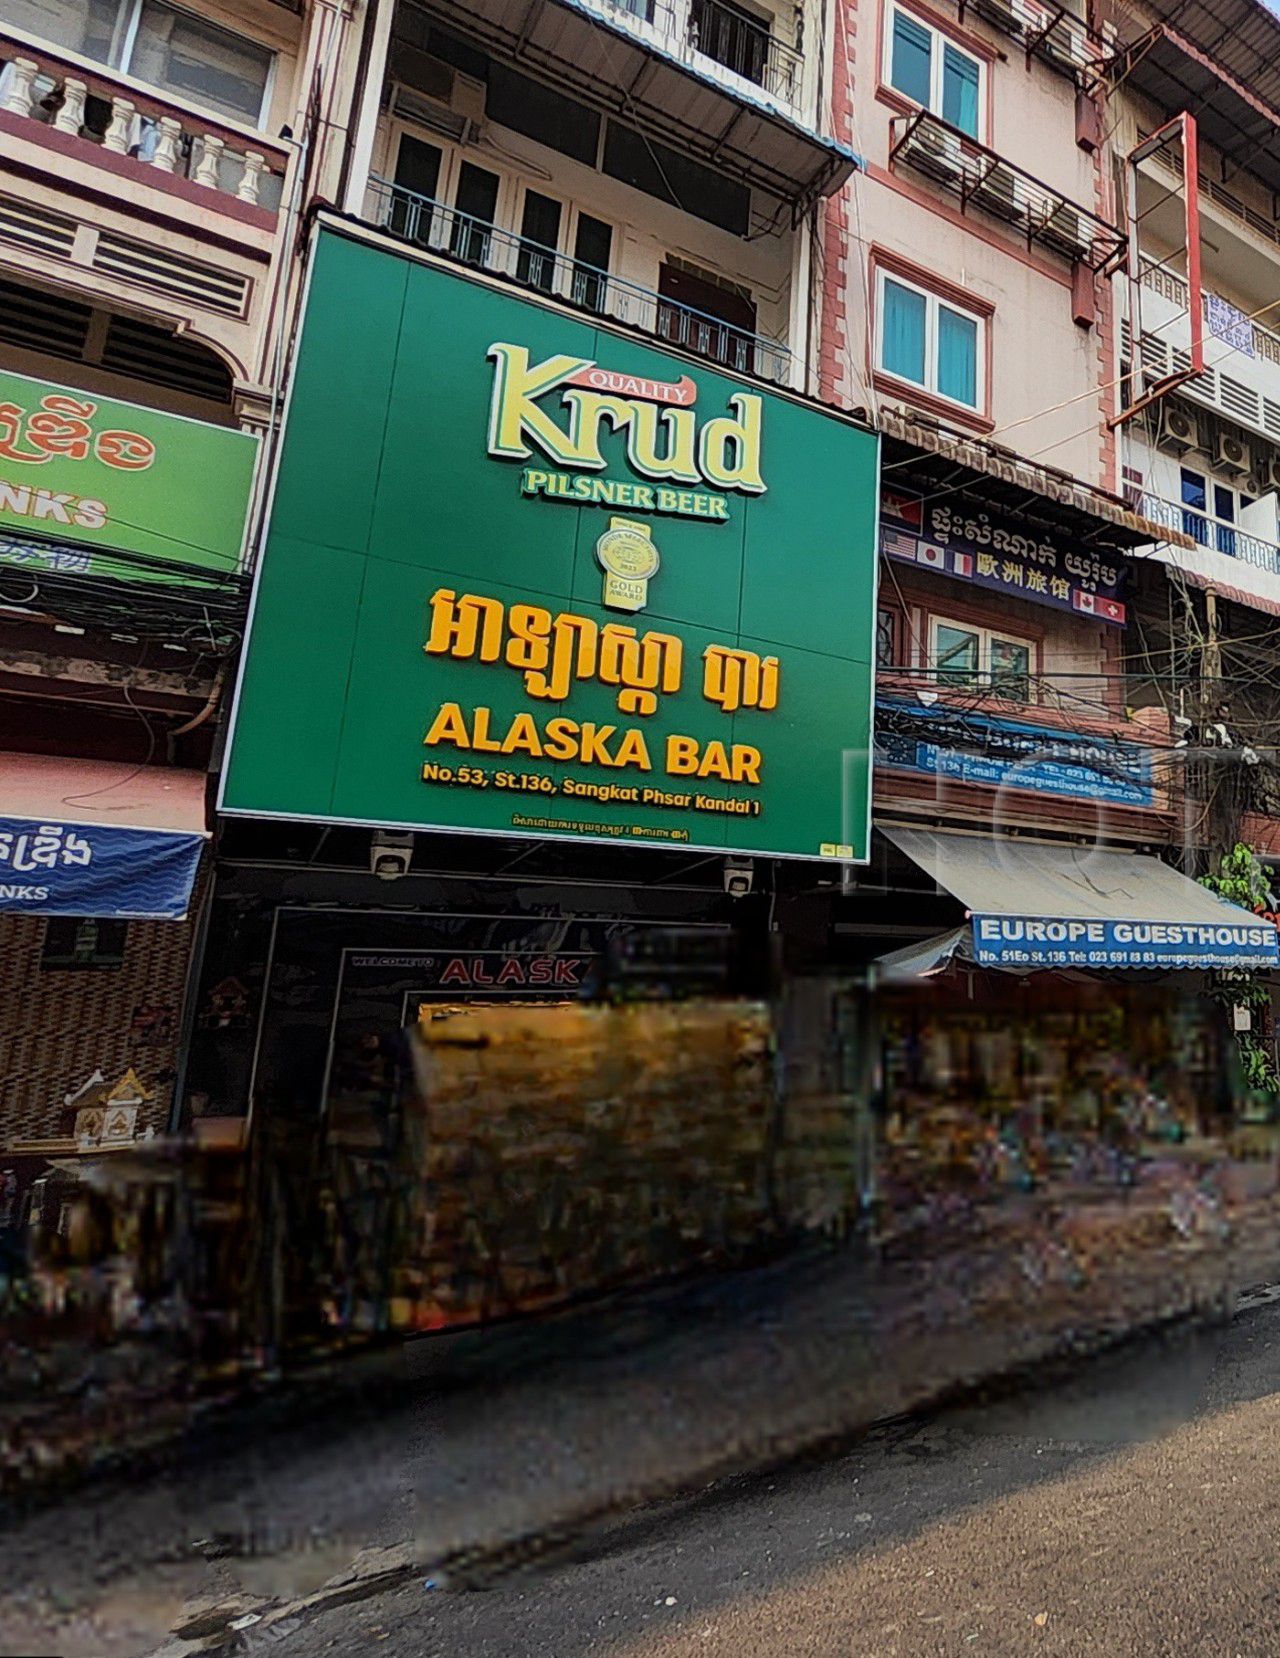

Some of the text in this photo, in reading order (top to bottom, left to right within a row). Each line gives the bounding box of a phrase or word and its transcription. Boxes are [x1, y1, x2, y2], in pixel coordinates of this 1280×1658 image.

[588, 369, 688, 403] QUALITY
[487, 342, 768, 493] Krud
[526, 469, 730, 519] PILSNER BEER
[608, 589, 643, 601] AWARD
[610, 580, 643, 594] GOLD
[423, 702, 762, 784] ALASKA BAR
[963, 763, 999, 780] E-mail:
[423, 764, 488, 789] No.53,
[495, 772, 558, 795] St.136,
[563, 780, 639, 803] Sangkat
[643, 789, 691, 809] Phsar
[695, 796, 750, 814] Kandal
[980, 919, 1276, 948] EUROPE GUESTHOUSE
[352, 956, 414, 967] WELCOME
[439, 958, 593, 985] ALASK
[979, 951, 999, 962] No.
[1088, 951, 1108, 963] 023
[1109, 951, 1127, 963] 691
